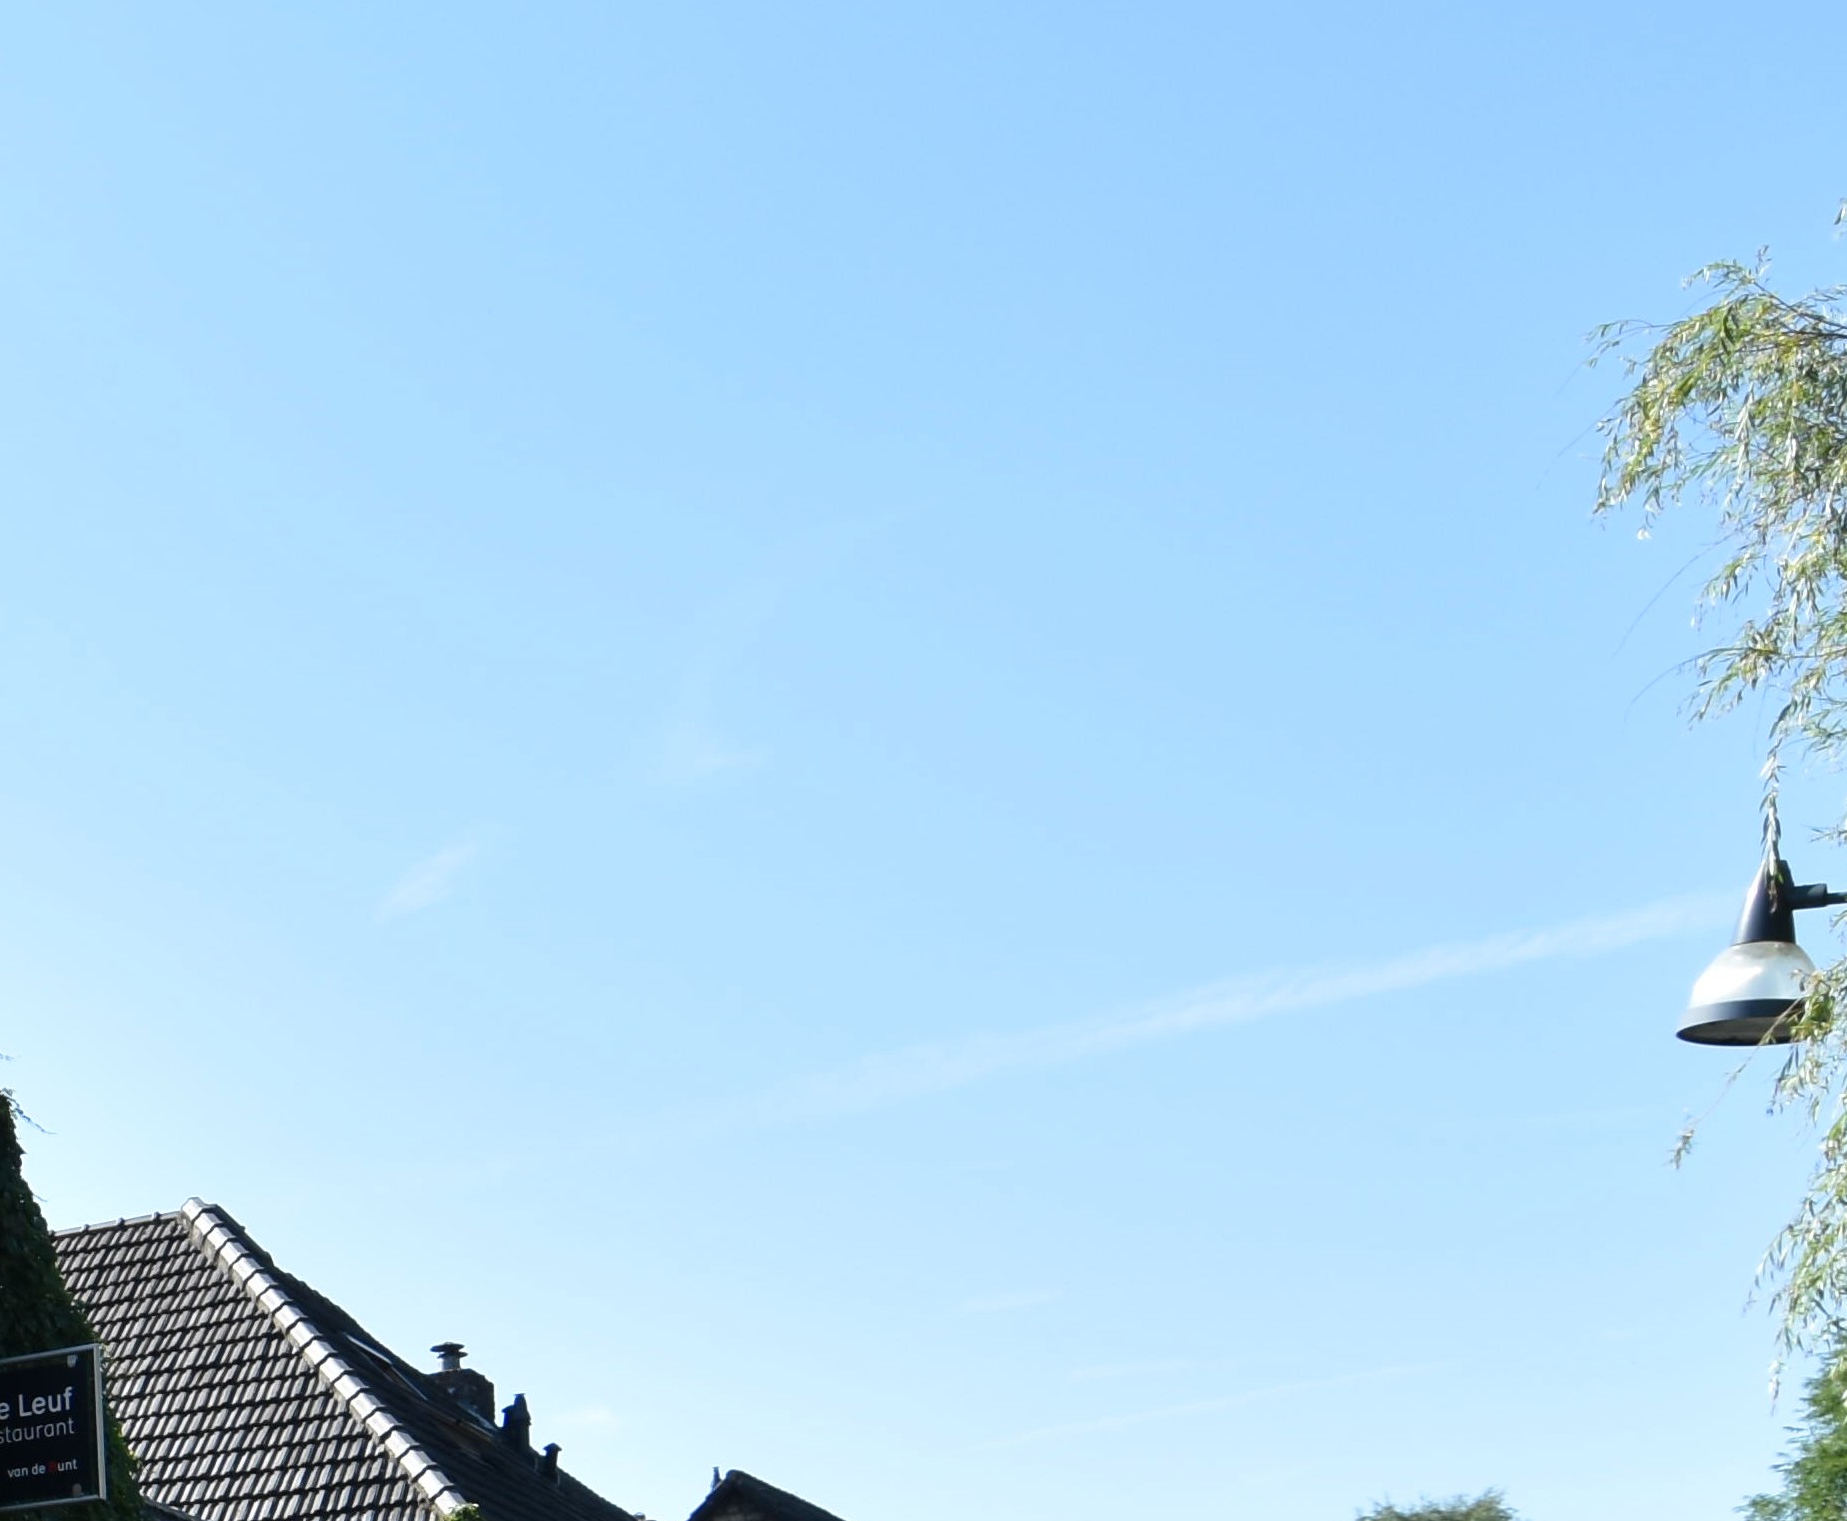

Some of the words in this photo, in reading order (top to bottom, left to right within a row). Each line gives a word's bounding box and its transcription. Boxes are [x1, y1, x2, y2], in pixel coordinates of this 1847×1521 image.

[17, 1385, 73, 1417] Leuf
[7, 1466, 28, 1478] van
[31, 1463, 46, 1476] de
